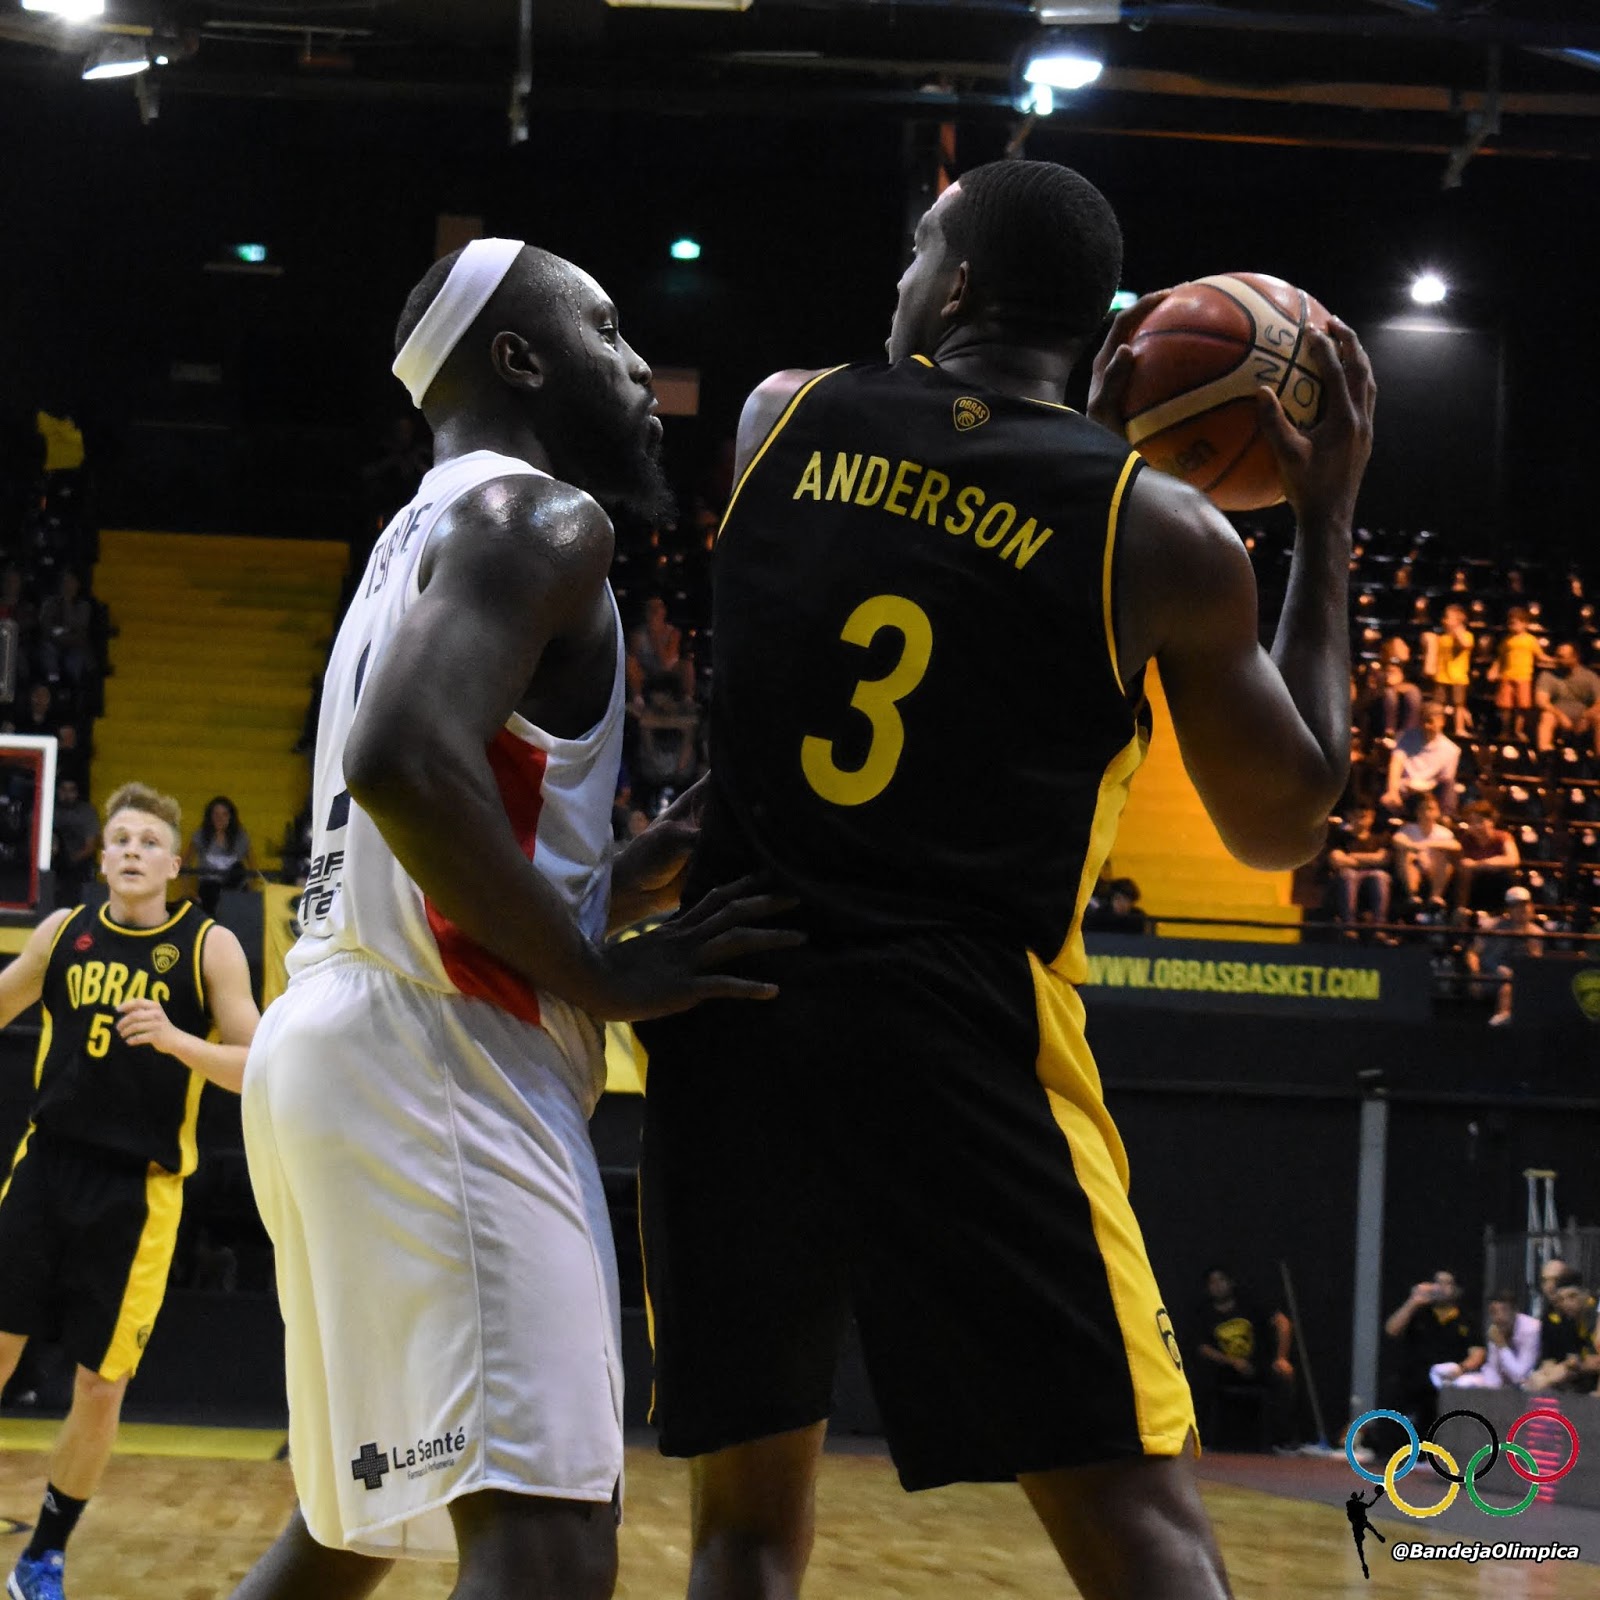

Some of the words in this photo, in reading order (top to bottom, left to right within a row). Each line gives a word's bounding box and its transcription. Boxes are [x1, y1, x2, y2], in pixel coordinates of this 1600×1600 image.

[958, 399, 987, 420] OBRAS
[792, 450, 1054, 570] ANDERSON
[800, 594, 933, 806] 3
[1087, 954, 1381, 1000] WWW.OBRASBASKET.COM
[87, 1012, 115, 1059] 5
[392, 1446, 417, 1470] La
[417, 1426, 466, 1462] Santé
